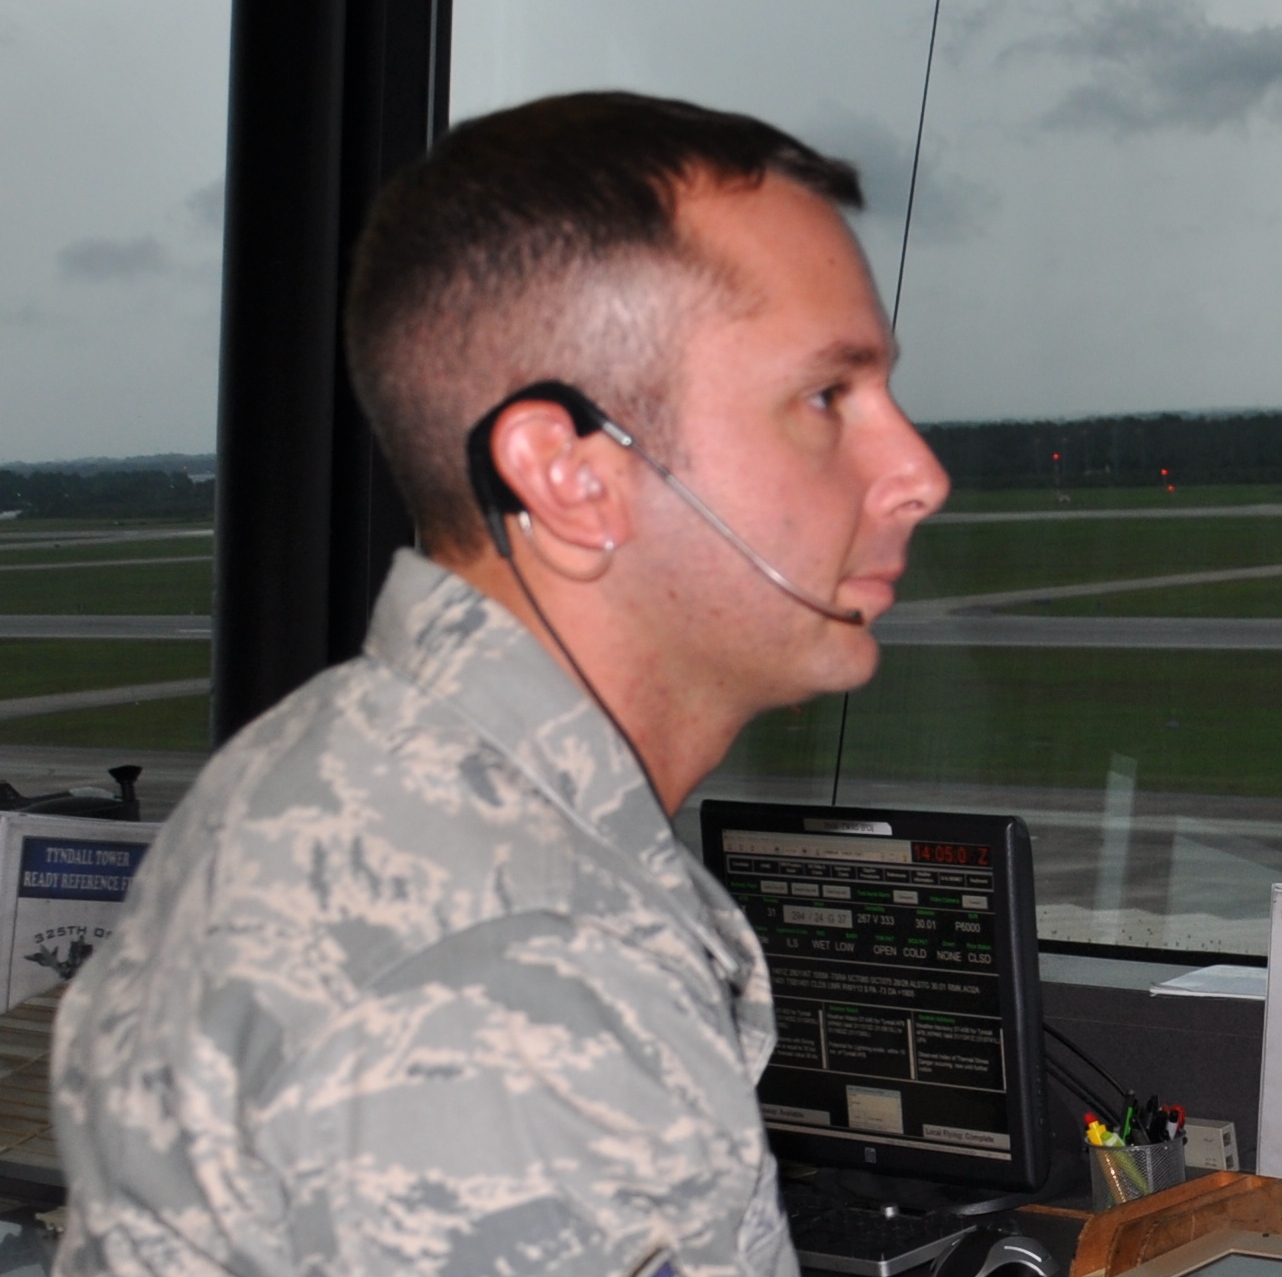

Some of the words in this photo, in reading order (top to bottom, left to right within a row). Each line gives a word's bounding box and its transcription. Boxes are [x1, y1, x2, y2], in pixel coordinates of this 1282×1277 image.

[46, 847, 93, 865] TYNDALL
[96, 851, 130, 867] TOWER
[23, 871, 58, 888] READY
[61, 873, 120, 891] REFERENCE
[34, 925, 87, 944] 325TH
[812, 939, 830, 950] WET
[835, 940, 855, 952] LOW
[873, 944, 897, 956] OPEN
[903, 946, 927, 959] COLD
[937, 950, 962, 963] NONE
[968, 952, 991, 964] CLSD
[925, 1127, 945, 1137] Local
[965, 1133, 994, 1144] Complete
